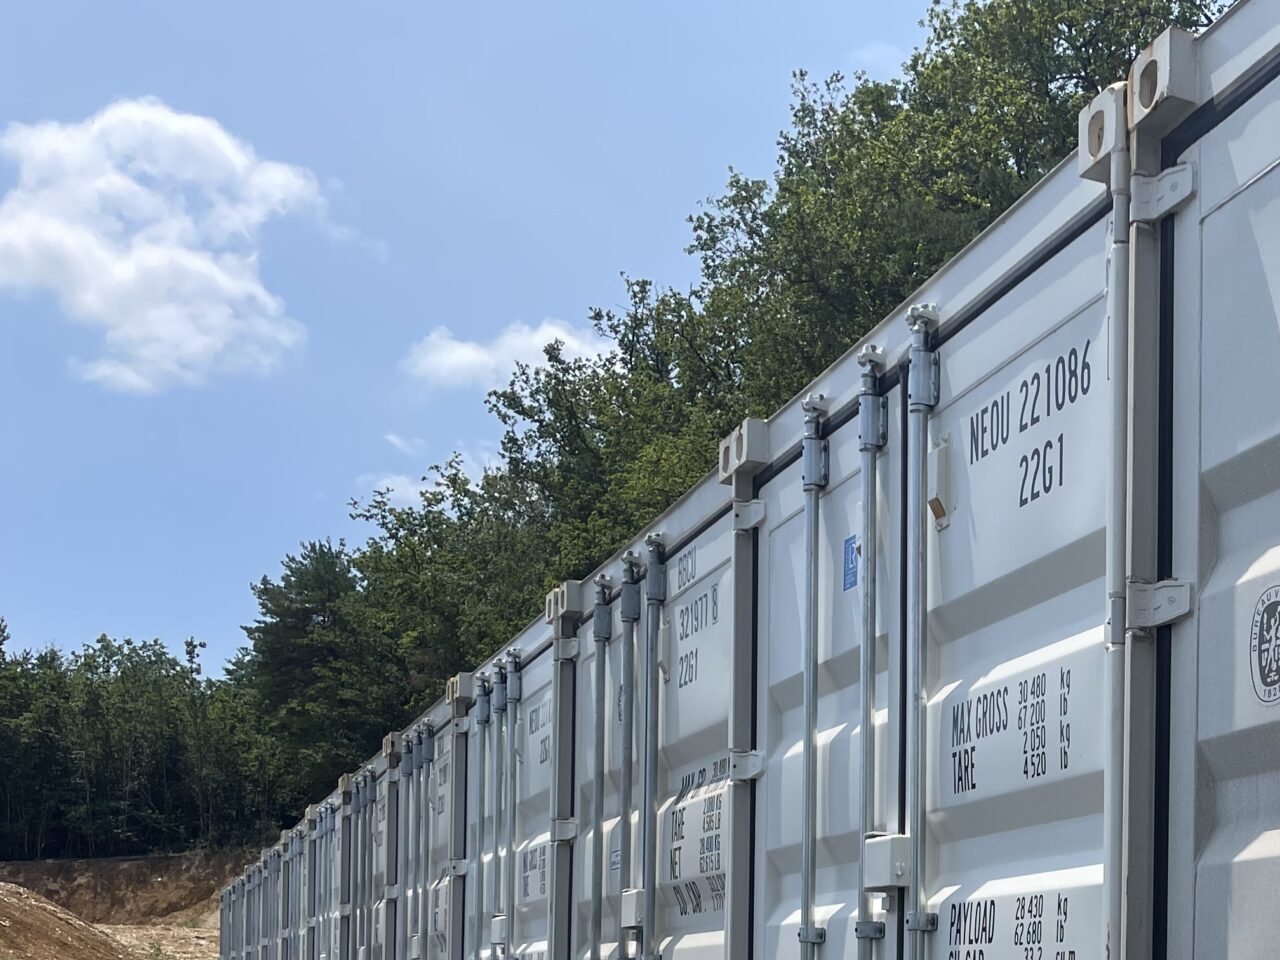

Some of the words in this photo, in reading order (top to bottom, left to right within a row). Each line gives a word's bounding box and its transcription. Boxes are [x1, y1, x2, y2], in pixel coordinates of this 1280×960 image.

[970, 391, 1010, 465] NEOU
[1019, 338, 1091, 433] 221086
[1019, 433, 1064, 508] 22G1
[679, 593, 708, 641] 321977
[1252, 592, 1271, 652] BUREAU
[679, 648, 698, 689] 22G1
[952, 699, 972, 747] MAX
[975, 686, 1009, 740] GROSS
[1060, 666, 1071, 695] kg
[1060, 694, 1068, 717] lb
[952, 746, 976, 795] TARE
[1060, 720, 1071, 749] kg
[1060, 747, 1068, 770] lb
[671, 807, 686, 843] TARE
[670, 846, 682, 881] NET
[949, 900, 996, 946] PAYLOAD
[1057, 893, 1068, 923] kg
[1056, 919, 1064, 943] lb
